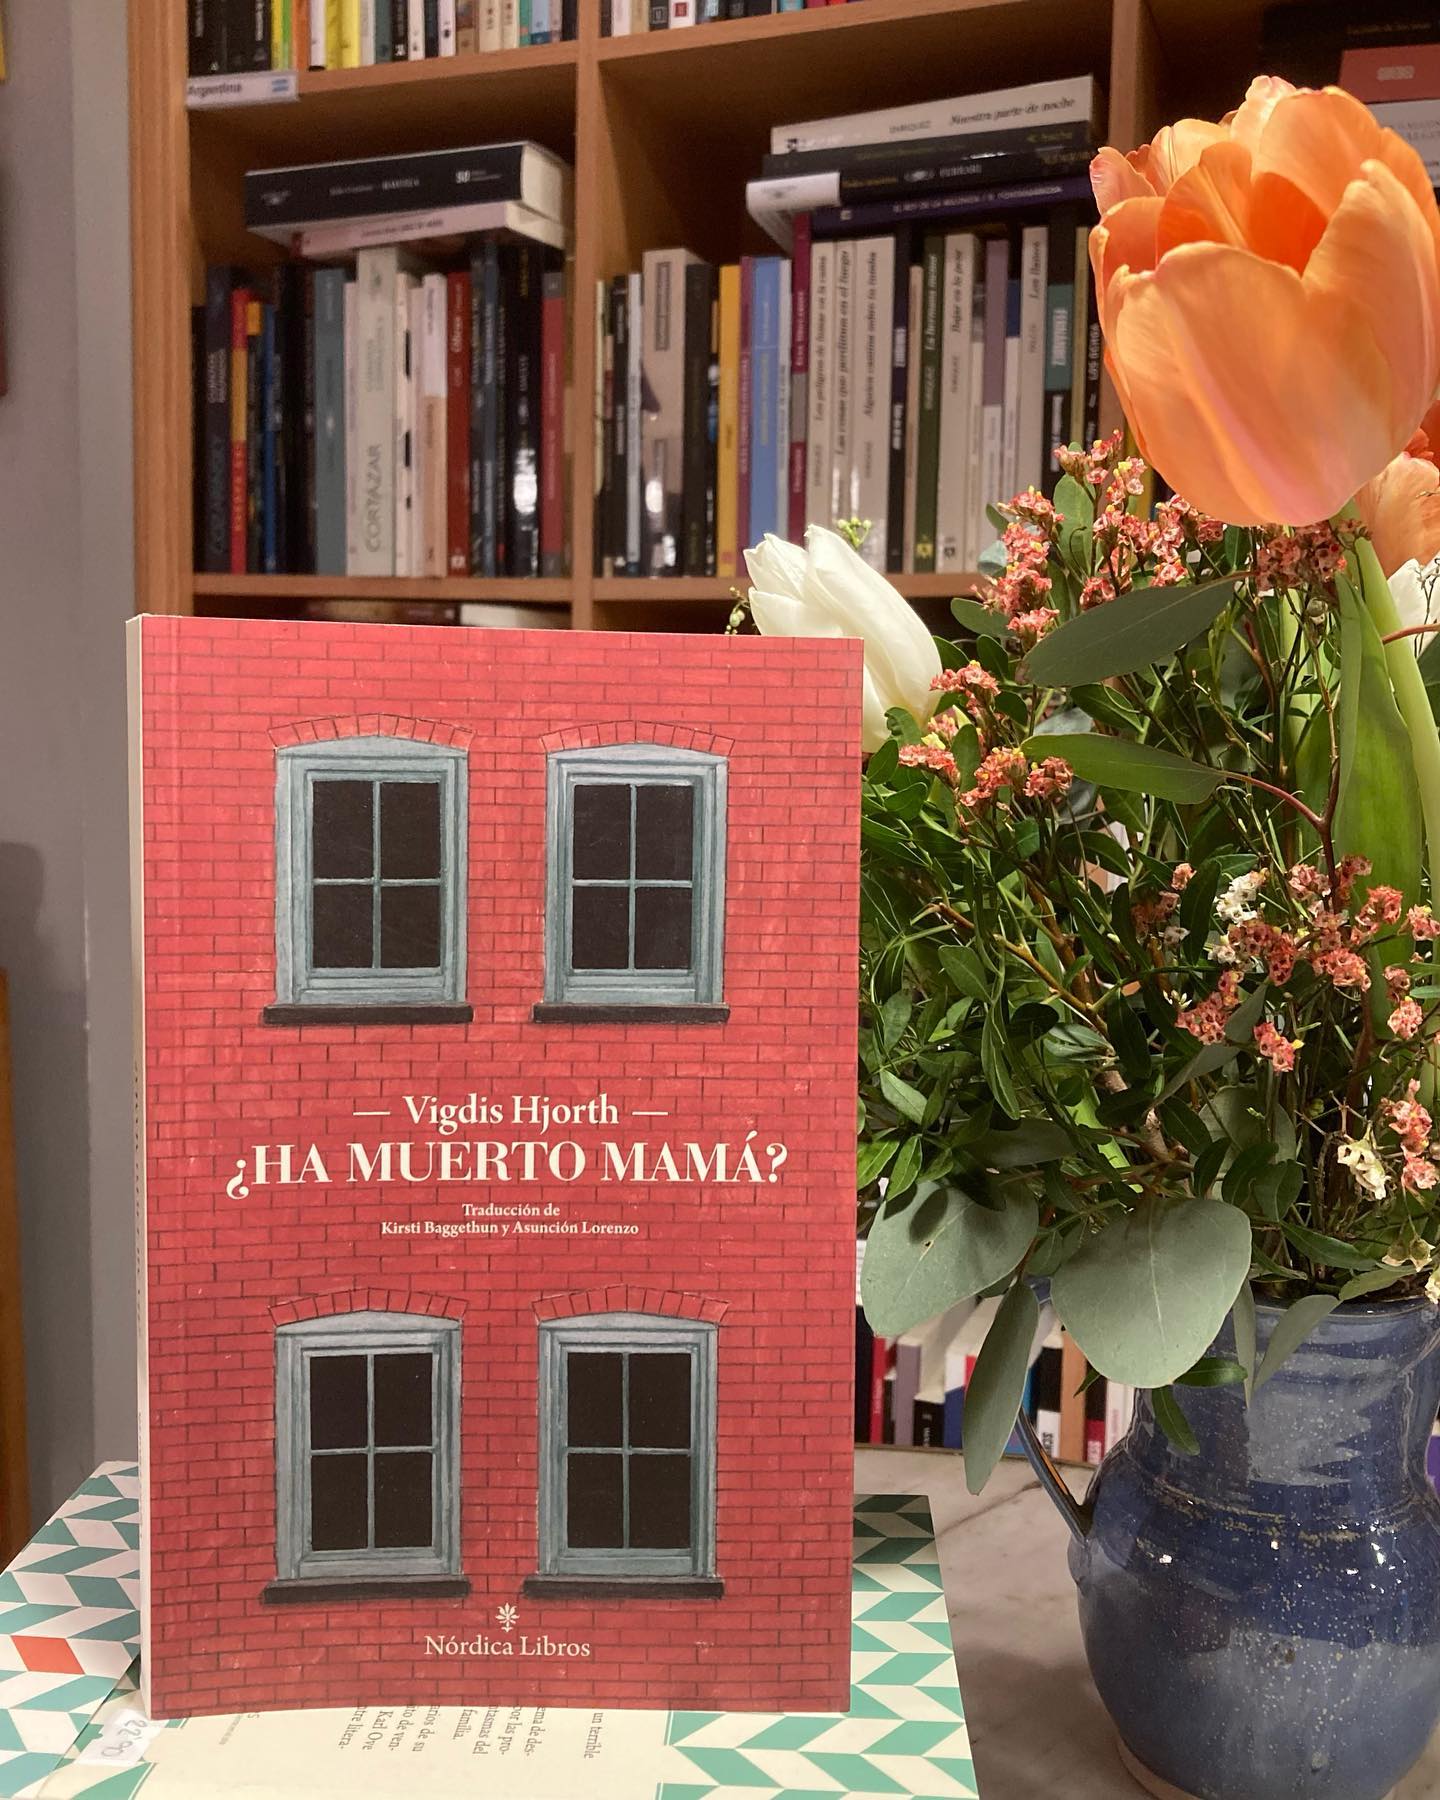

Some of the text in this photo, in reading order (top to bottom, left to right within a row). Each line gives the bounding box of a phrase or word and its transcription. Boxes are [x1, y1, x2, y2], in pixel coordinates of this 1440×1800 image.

[403, 1093, 619, 1135] Vigdis Hjorth
[226, 1131, 788, 1200] ¿HA MUERTO MAMÁ?
[462, 1203, 561, 1217] Traducción de
[381, 1221, 640, 1238] Kirsti Baggethun y Asunción Lorenzo
[424, 1635, 591, 1657] Nórdica Libros
[362, 1710, 394, 1751] Karl Ove
[396, 1719, 415, 1731] de
[418, 1728, 435, 1739] de
[452, 1708, 478, 1741] familia.
[504, 1722, 523, 1735] las
[528, 1725, 546, 1737] de
[338, 1723, 364, 1750] litera-
[388, 1731, 405, 1751] ven-
[498, 1735, 513, 1755] pro-
[583, 1712, 604, 1759] un terrible
[412, 1741, 425, 1752] su
[472, 1740, 491, 1755] del
[524, 1737, 542, 1756] des-
